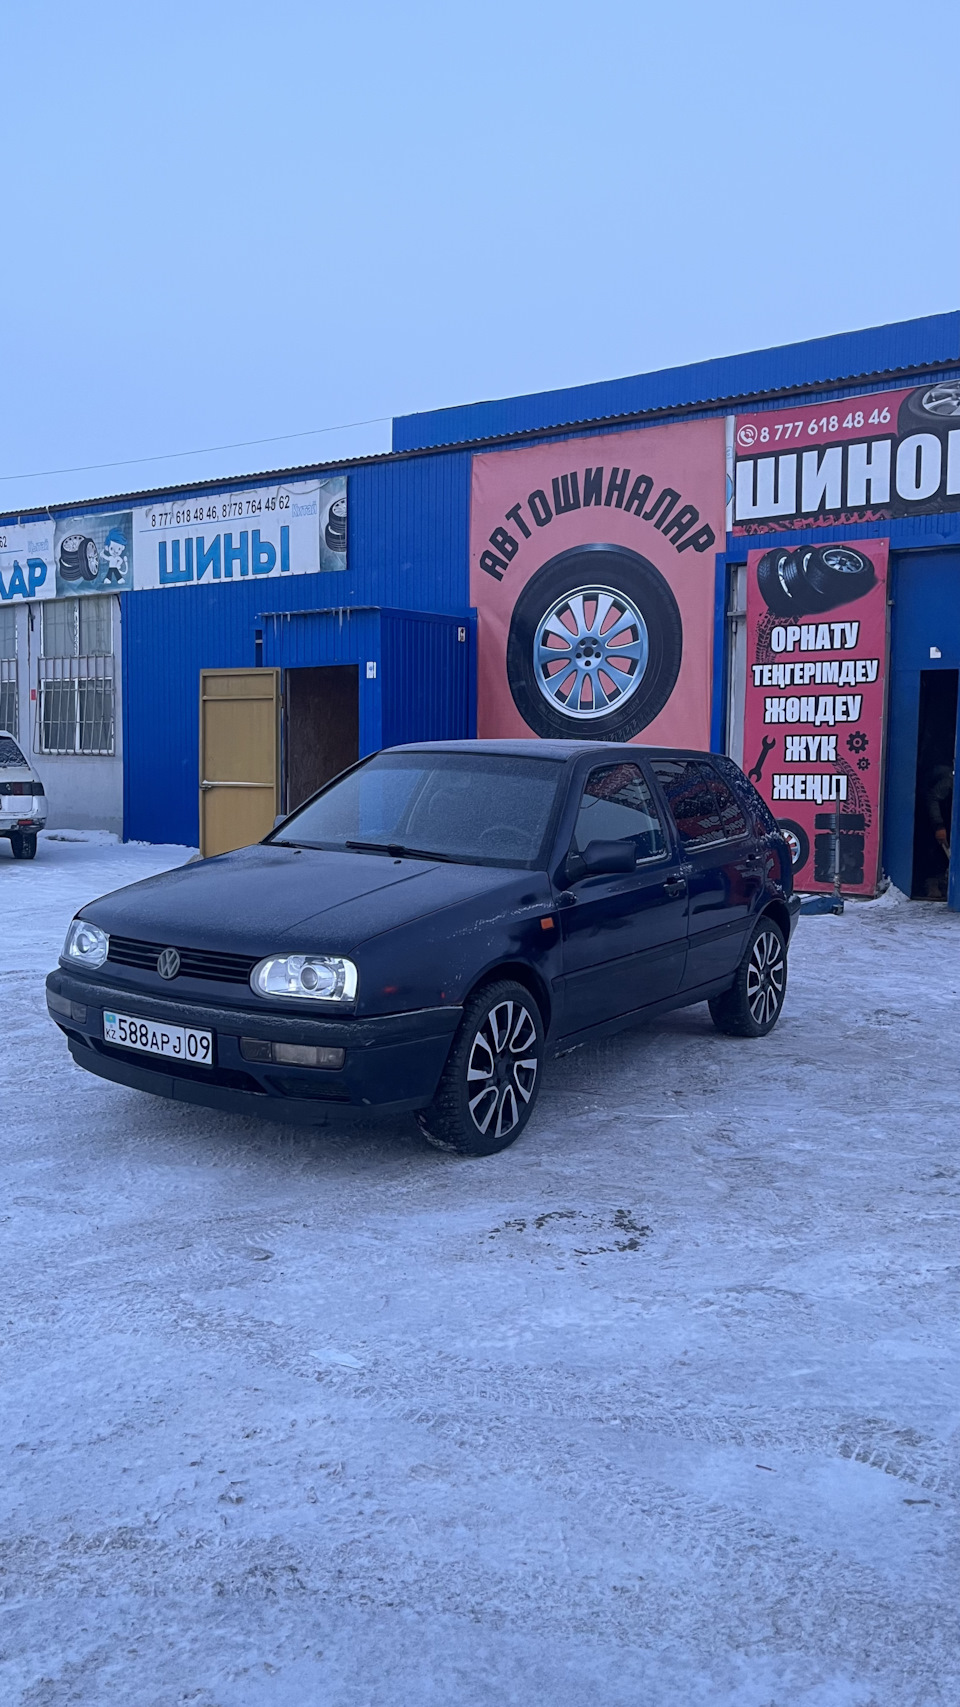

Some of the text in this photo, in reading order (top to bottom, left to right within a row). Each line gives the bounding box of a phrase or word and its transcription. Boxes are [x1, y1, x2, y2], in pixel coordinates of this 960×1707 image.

[760, 406, 891, 442] 8 777 618 48 46
[151, 514, 156, 527] 8
[159, 511, 172, 526] 777
[176, 509, 191, 524] 618
[194, 507, 204, 521] 48
[222, 502, 243, 518] 8778
[246, 499, 262, 514] 764
[265, 497, 276, 511] 45
[278, 495, 290, 509] 62
[479, 466, 716, 582] АВТОШИНАЛАР
[158, 525, 290, 584] ШИНЫ
[771, 622, 859, 653] ОРНАТУ
[752, 660, 879, 688] ТЕҢГЕРІМДЕУ
[764, 695, 862, 726] ЖӨНДЕУ
[784, 735, 837, 761] ЖҮК
[772, 774, 848, 804] ЖЕҢІЛ
[105, 1027, 117, 1040] KZ
[187, 1033, 210, 1060] 09
